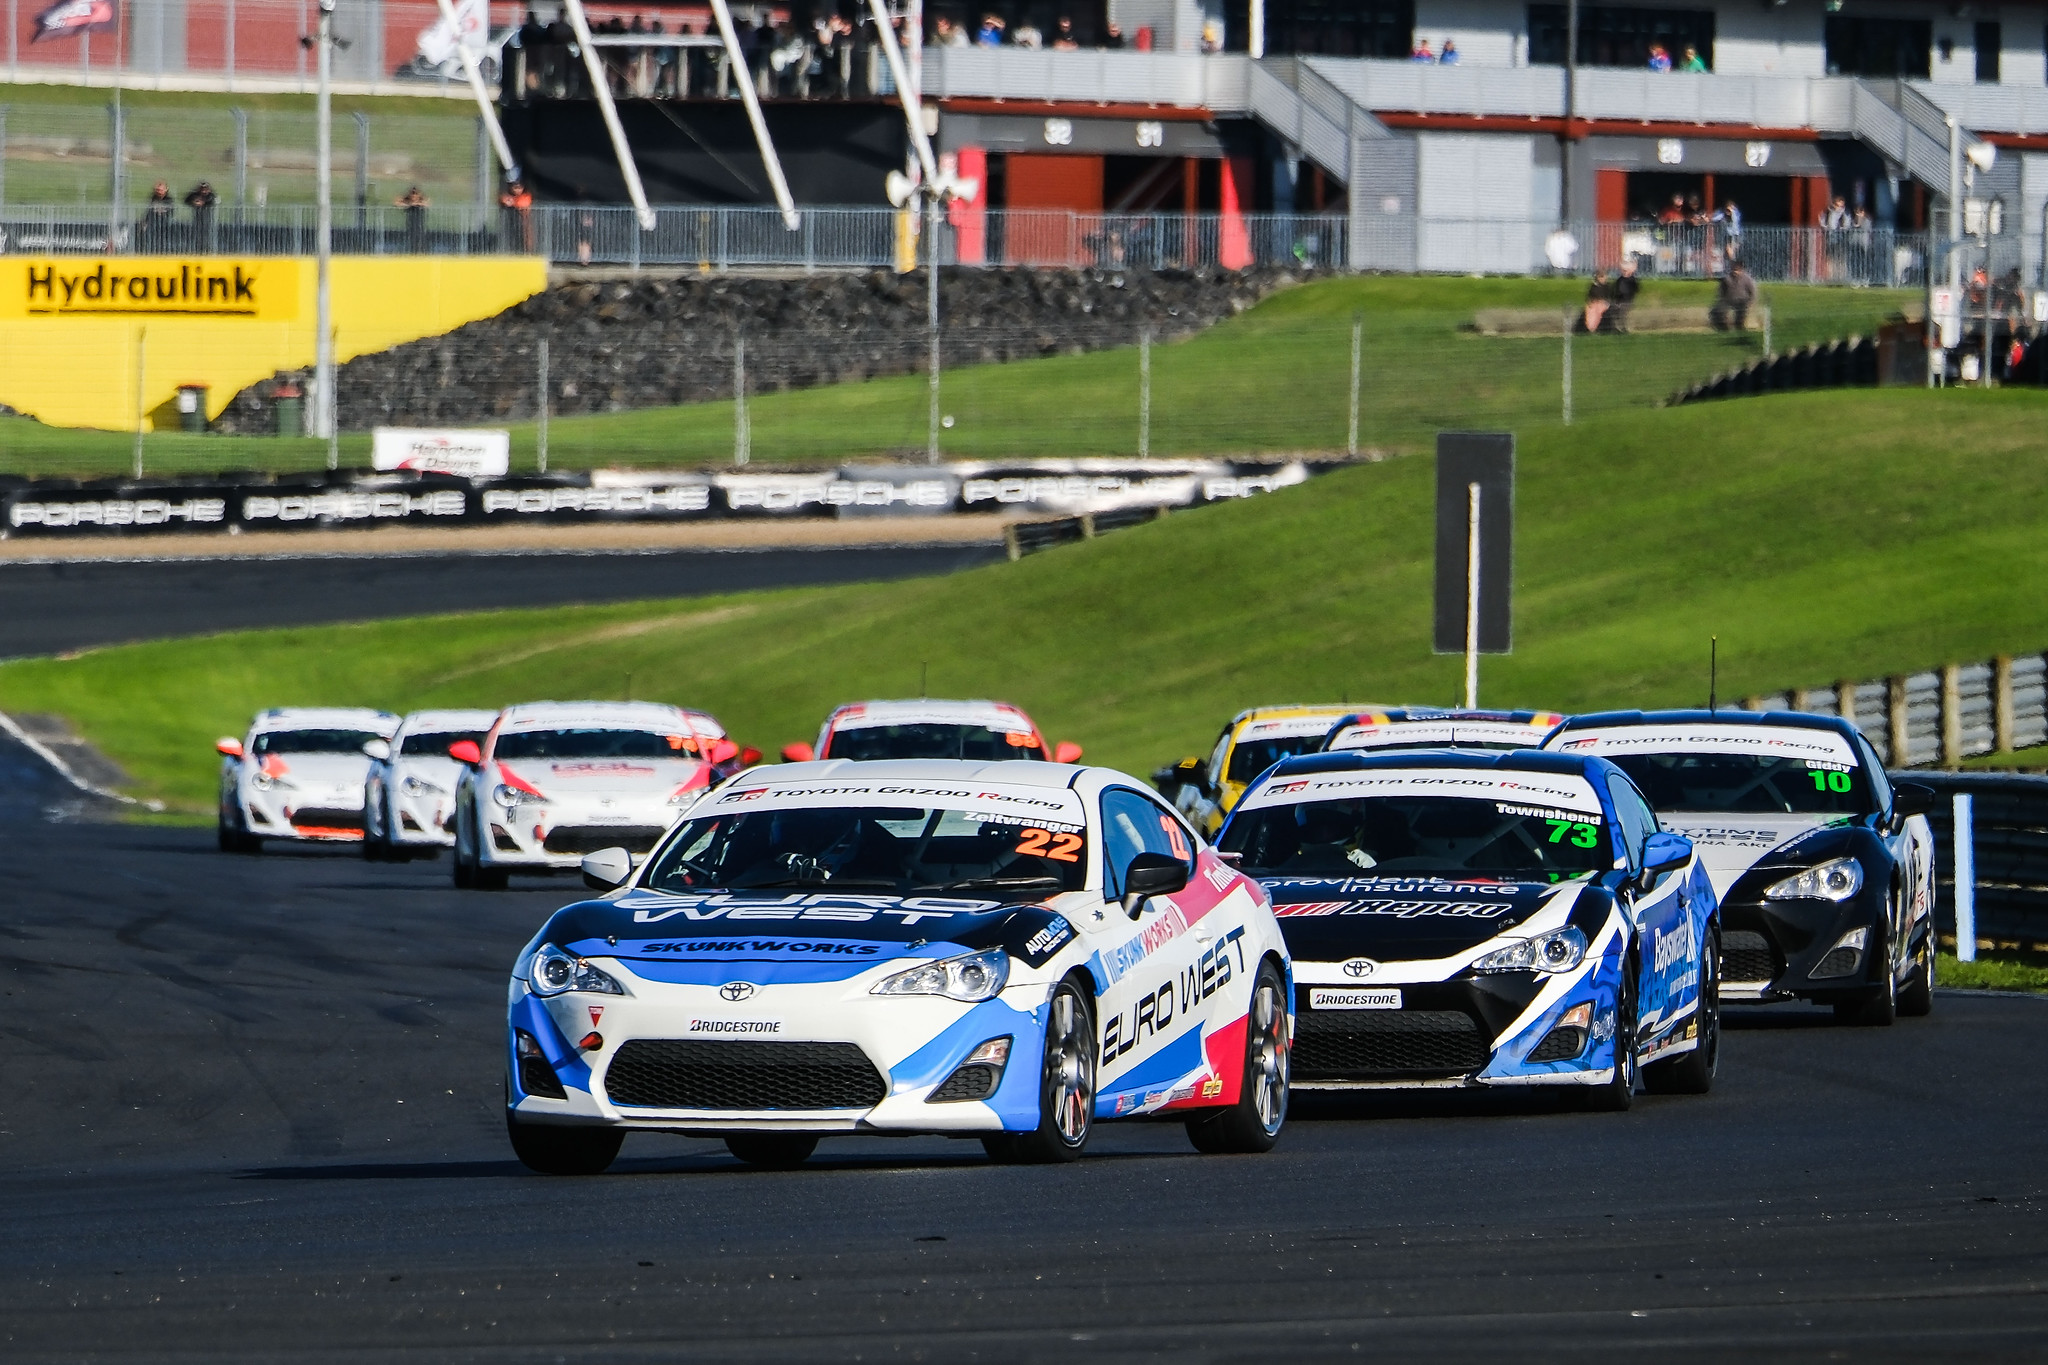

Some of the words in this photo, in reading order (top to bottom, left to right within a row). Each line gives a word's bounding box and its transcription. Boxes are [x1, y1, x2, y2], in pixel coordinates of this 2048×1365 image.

[29, 264, 256, 307] Hydraulink
[243, 490, 466, 523] PORSCHE
[482, 485, 710, 514] PORSCHE
[727, 480, 949, 510] PORSCHE
[10, 499, 225, 527] PORSCHE
[1603, 737, 1682, 747] TOYOTA
[1688, 736, 1762, 744] GAZOO
[1768, 740, 1835, 753] Racing
[1805, 760, 1851, 774] Giddy
[1313, 779, 1403, 790] TOYOTA
[1410, 778, 1494, 787] GAZOO
[1500, 781, 1577, 798] Racing
[1807, 770, 1852, 793] 10
[773, 787, 870, 798] TOYOTA
[877, 786, 971, 798] GAZOO
[976, 792, 1064, 811] Racing
[963, 811, 1083, 834] Zeltwanger
[1495, 803, 1602, 826] Townshend
[1545, 819, 1598, 849] 73
[1667, 827, 1778, 837] YTIME
[1015, 828, 1083, 863] 22
[1260, 876, 1445, 888] provident
[613, 893, 1002, 913] EURO
[633, 906, 954, 925] WEST
[641, 941, 881, 955] SKUNKWORKS
[1102, 980, 1175, 1068] EURO
[1180, 924, 1246, 1015] WEST
[1315, 993, 1398, 1005] BRIDGESTONE
[689, 1019, 782, 1033] BRIDGESTONE
